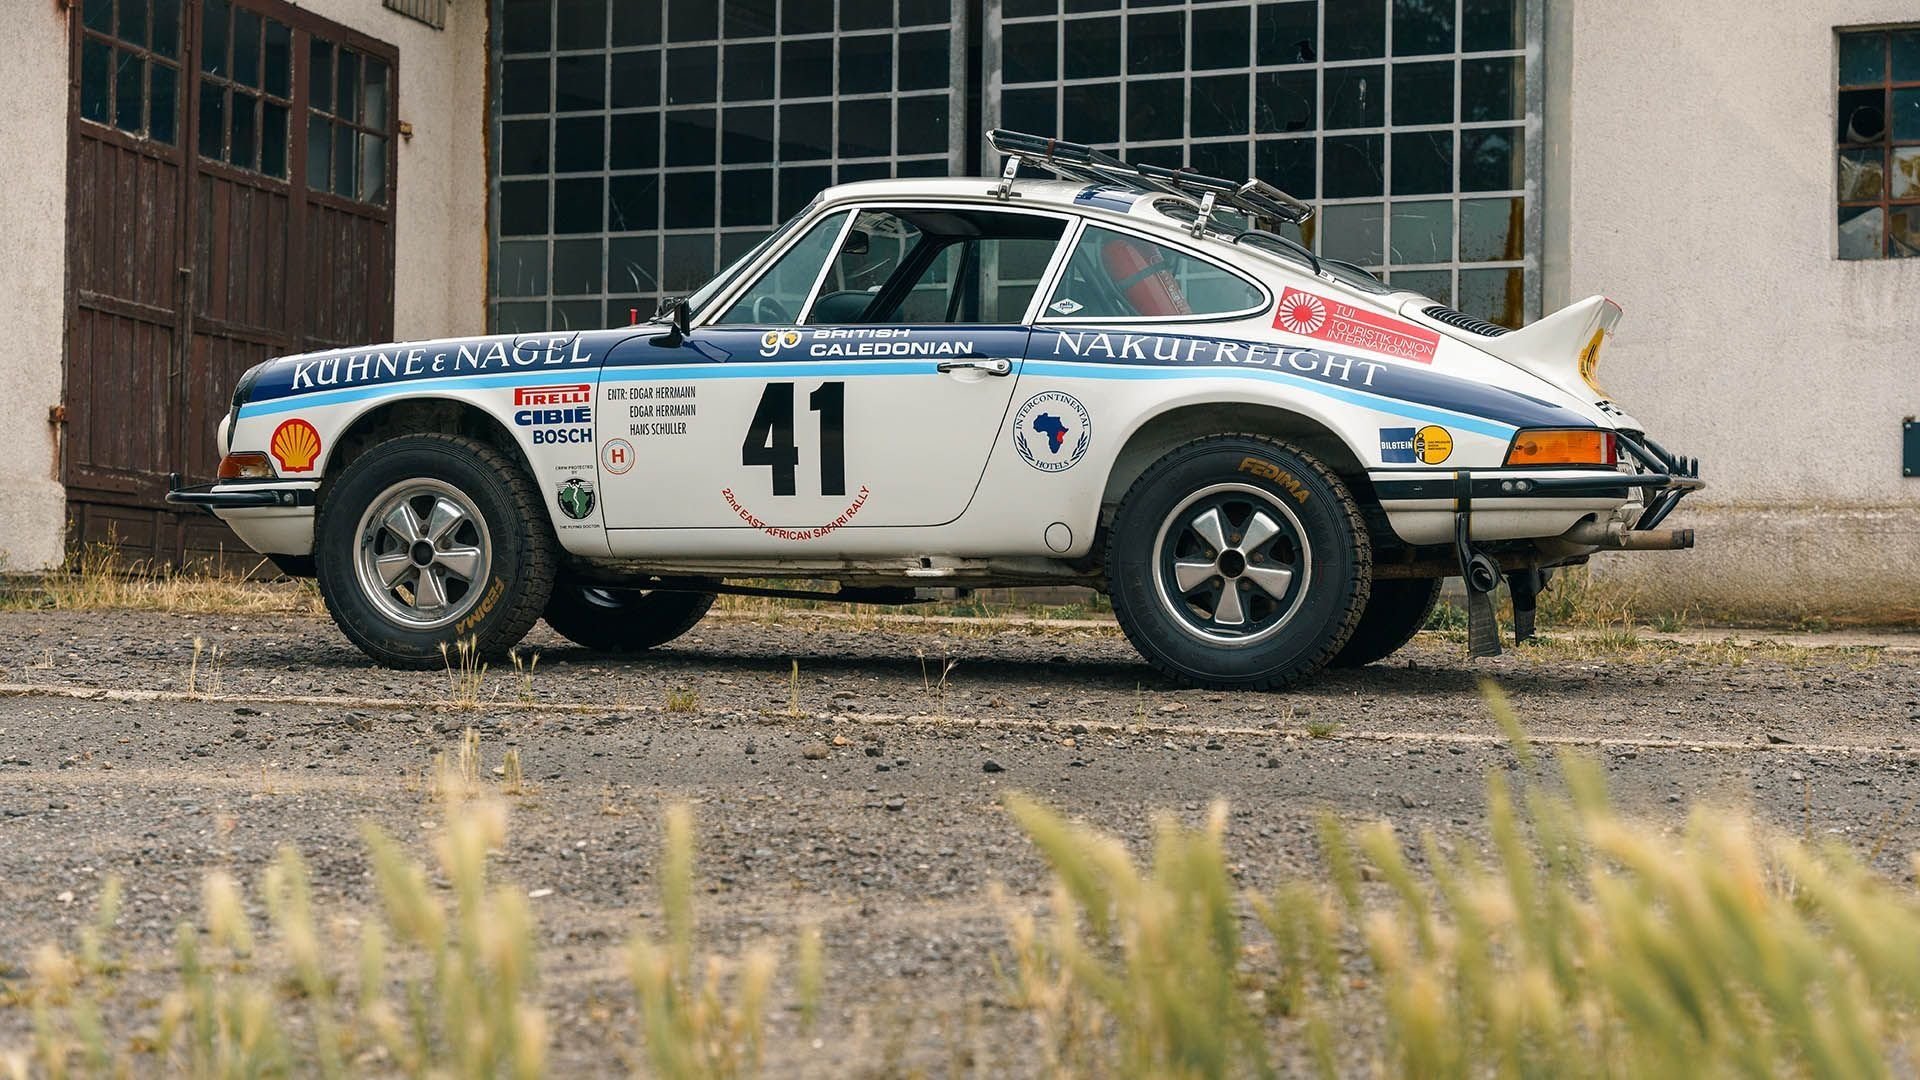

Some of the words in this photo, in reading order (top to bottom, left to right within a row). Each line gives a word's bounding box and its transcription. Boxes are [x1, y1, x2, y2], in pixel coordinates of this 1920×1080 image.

[1335, 304, 1355, 318] TUI
[813, 328, 911, 339] BRITISH
[1331, 319, 1391, 344] TOURISTIK
[1393, 337, 1434, 355] UNION
[809, 341, 973, 357] CALEDONIAN
[1327, 330, 1419, 359] INTERNATIONAL
[291, 348, 427, 390] KÜHNE
[453, 336, 592, 371] NAGEL
[1053, 331, 1387, 387] NAKUFREIGHT
[514, 384, 591, 406] PIRELLI
[607, 388, 628, 400] ENTR:
[629, 387, 654, 400] EDGAR
[655, 386, 696, 399] HERRMANN
[629, 405, 654, 418] EDGAR
[655, 404, 696, 417] HERRMANN
[1016, 394, 1088, 429] INTERCONTINENTAL
[533, 428, 592, 444] BOSCH
[630, 423, 650, 436] HANS
[651, 422, 687, 435] SCHULLER
[742, 381, 846, 497] 41
[1381, 441, 1413, 450] BILSTEIN
[611, 448, 625, 464] H
[1036, 460, 1069, 470] HOTELS
[722, 488, 742, 512] 22nd
[739, 509, 765, 530] EAST
[765, 527, 811, 540] AFRICAN
[814, 514, 848, 538] SAFARI
[846, 485, 870, 518] RALLY
